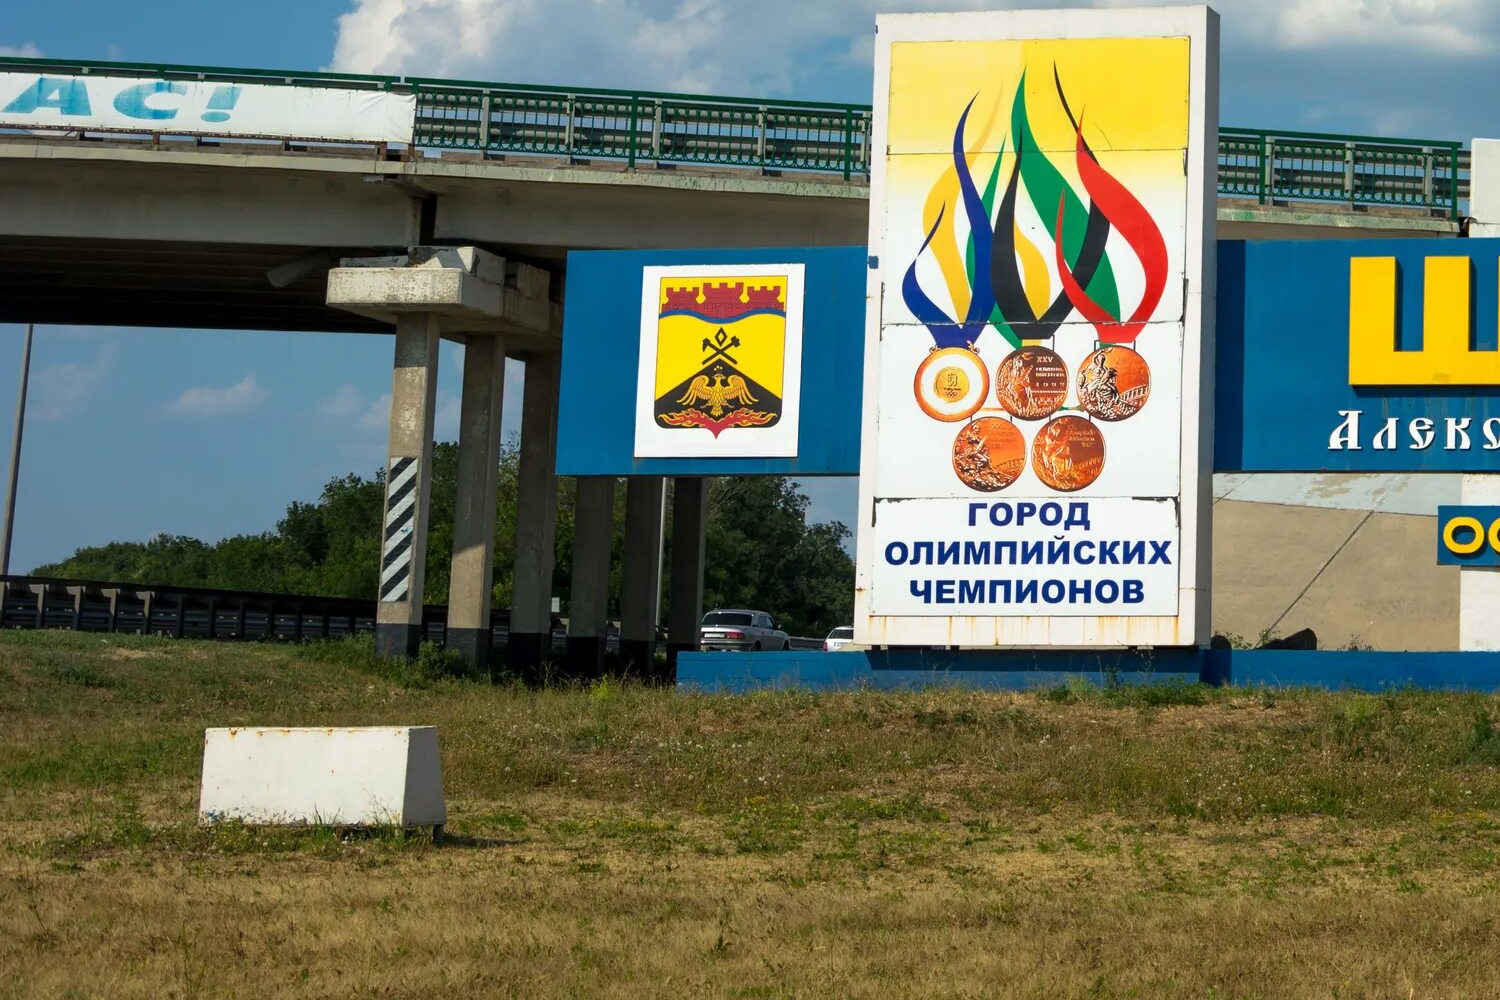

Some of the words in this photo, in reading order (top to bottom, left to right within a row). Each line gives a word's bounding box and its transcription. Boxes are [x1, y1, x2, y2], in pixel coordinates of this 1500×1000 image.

[968, 502, 1091, 530] ГОРОД
[884, 535, 1172, 566] ОЛИМПИЙСКИХ
[909, 579, 1145, 604] ЧЕМПИОНОВ
